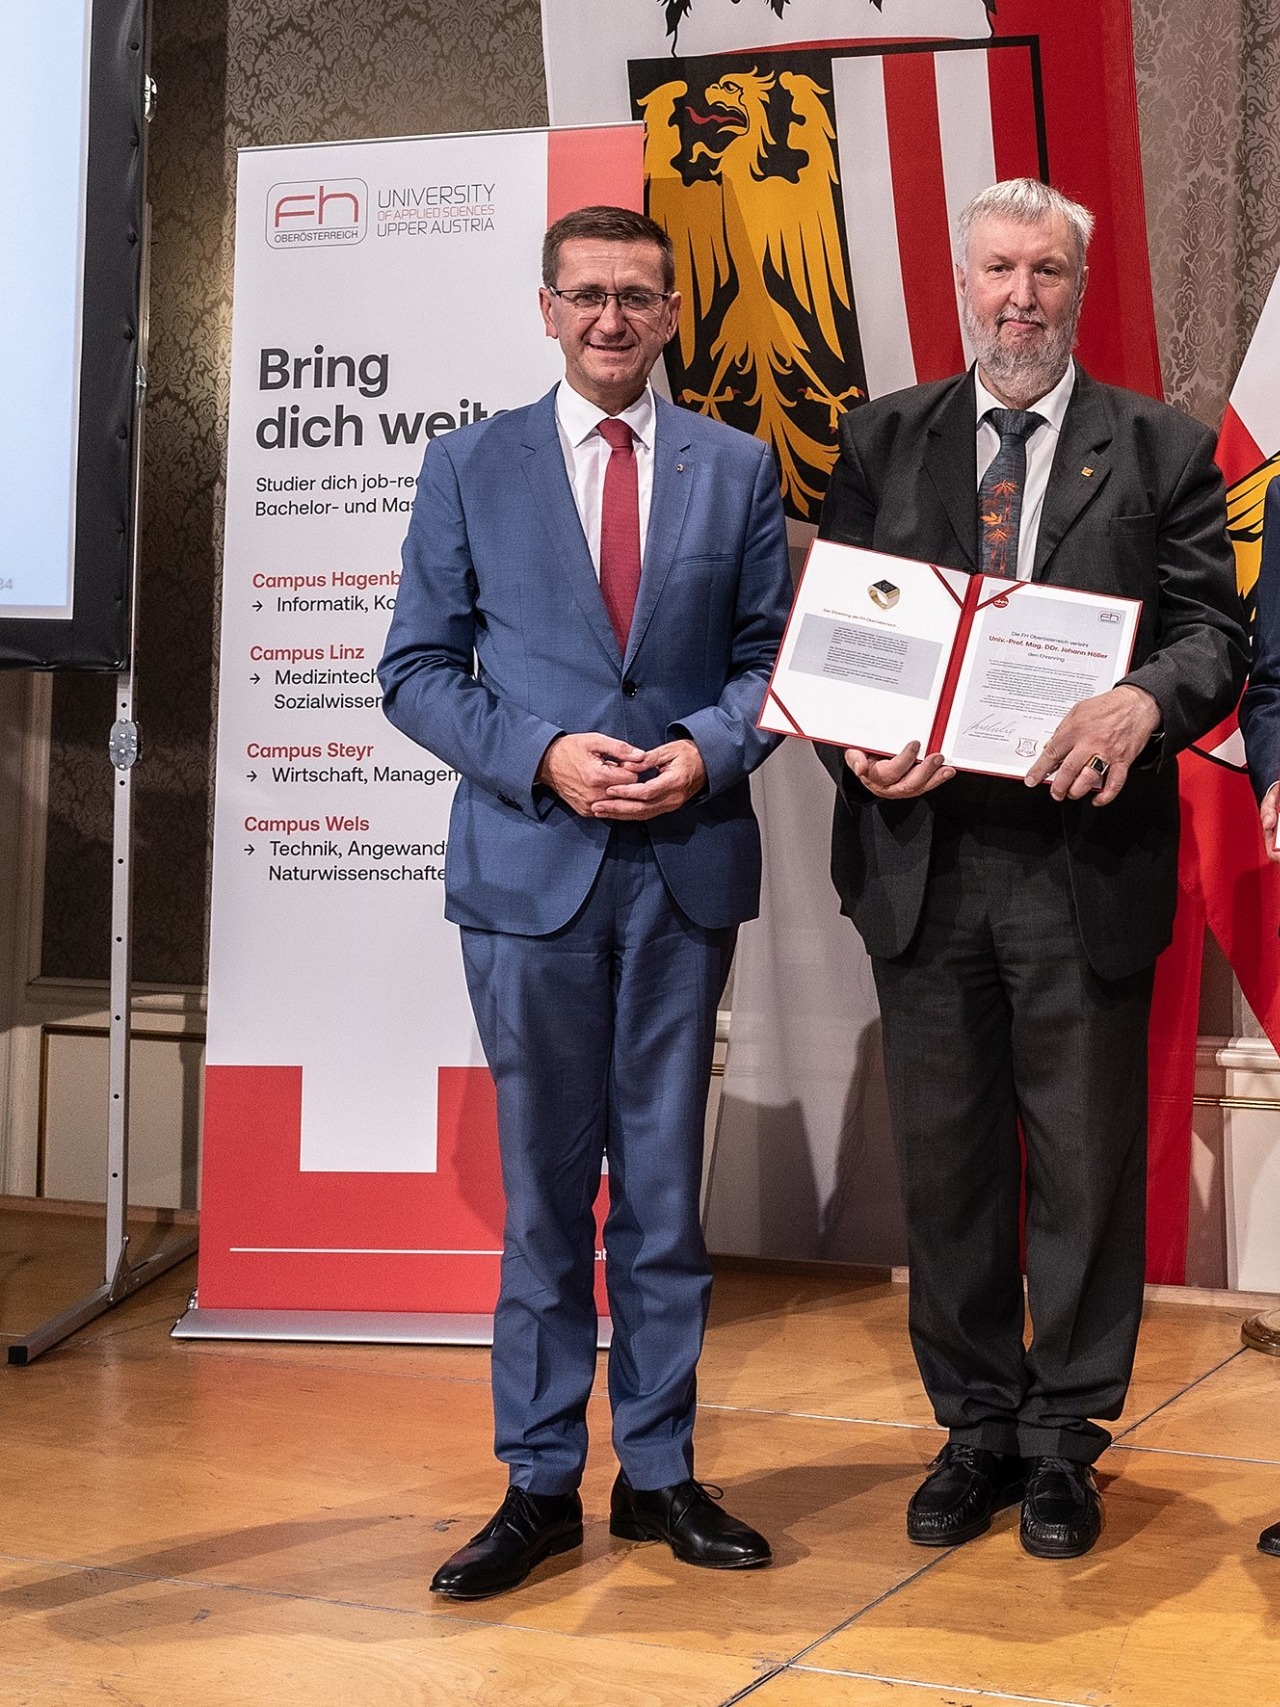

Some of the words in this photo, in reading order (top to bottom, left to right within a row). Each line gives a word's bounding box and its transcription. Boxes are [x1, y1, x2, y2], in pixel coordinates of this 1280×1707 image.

[377, 183, 496, 210] UNIVERSITY
[377, 210, 392, 222] OF
[394, 207, 440, 219] APPLIED
[442, 204, 495, 218] SCIENCES
[274, 230, 359, 243] OBERÖSTERREICH
[376, 219, 428, 238] UPPER
[430, 215, 495, 235] AUSTRIA
[258, 344, 389, 399] Bring
[255, 403, 364, 450] dich
[378, 398, 510, 445] weit
[255, 475, 317, 493] Studier
[320, 474, 358, 491] dich
[255, 499, 340, 517] Bachelor-
[344, 497, 377, 515] und
[252, 572, 327, 592] Campus
[331, 570, 401, 590] Hagenb
[276, 595, 369, 614] Informatik,
[249, 645, 325, 665] Campus
[329, 643, 365, 660] Linz
[1025, 641, 1043, 650] Mag.
[1044, 644, 1060, 652] DDr.
[1061, 646, 1087, 656] Johann
[246, 742, 323, 762] Campus
[326, 741, 375, 762] Steyr
[271, 766, 369, 785] Wirtschaft,
[244, 816, 321, 836] Campus
[324, 815, 370, 832] Wels
[269, 840, 343, 859] Technik,
[347, 840, 448, 860] Angewand
